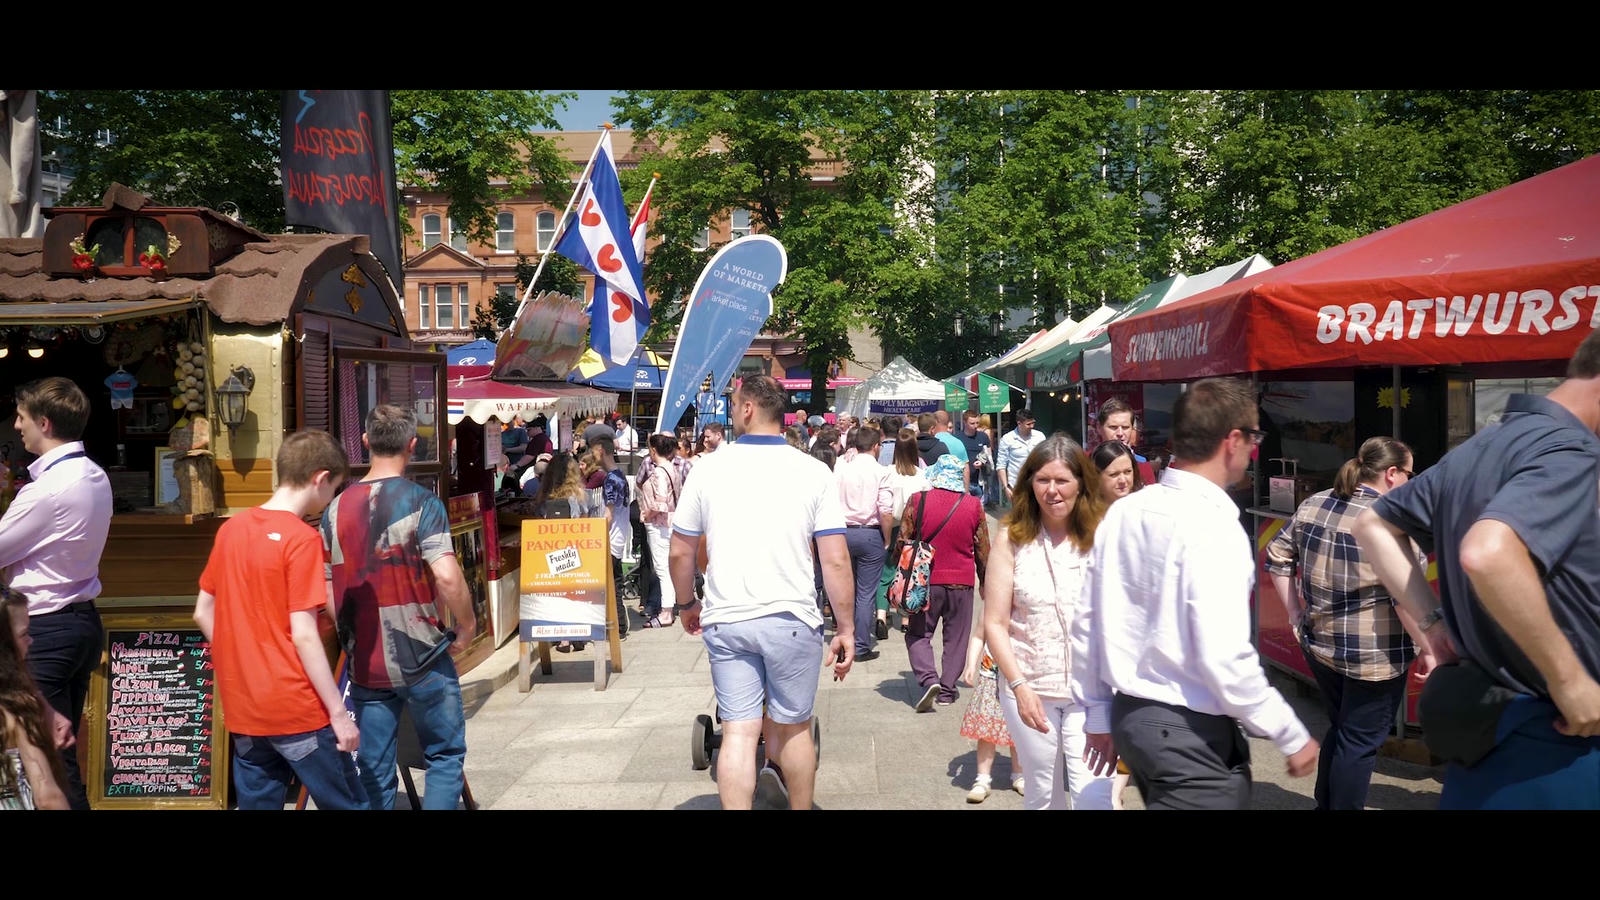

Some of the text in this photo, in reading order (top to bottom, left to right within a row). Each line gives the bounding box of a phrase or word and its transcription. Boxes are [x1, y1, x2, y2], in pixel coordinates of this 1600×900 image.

[723, 262, 764, 281] A WORLD
[713, 269, 768, 294] OF MARKETS
[1125, 320, 1210, 364] SCHWENKGRILL
[496, 402, 557, 412] WAFFLES
[537, 523, 591, 535] DUTCH
[526, 539, 602, 551] PANCAKES
[549, 549, 577, 564] Freshly
[555, 559, 576, 572] made
[536, 626, 588, 635] Also take away
[135, 632, 180, 646] PIZZA
[112, 661, 149, 674] NAPOLI
[112, 677, 160, 690] CALZONE
[112, 690, 170, 703] PEPPERONI
[107, 713, 165, 730] DIAVOLA
[110, 730, 148, 742] TEXAS
[111, 742, 143, 755] POLLO
[154, 742, 187, 753] BACON
[110, 755, 169, 769] VEGETARIAN
[112, 773, 167, 785] CHOCOLATE
[168, 773, 194, 783] PIZZA
[107, 785, 177, 795] EXTRA TOPPING
